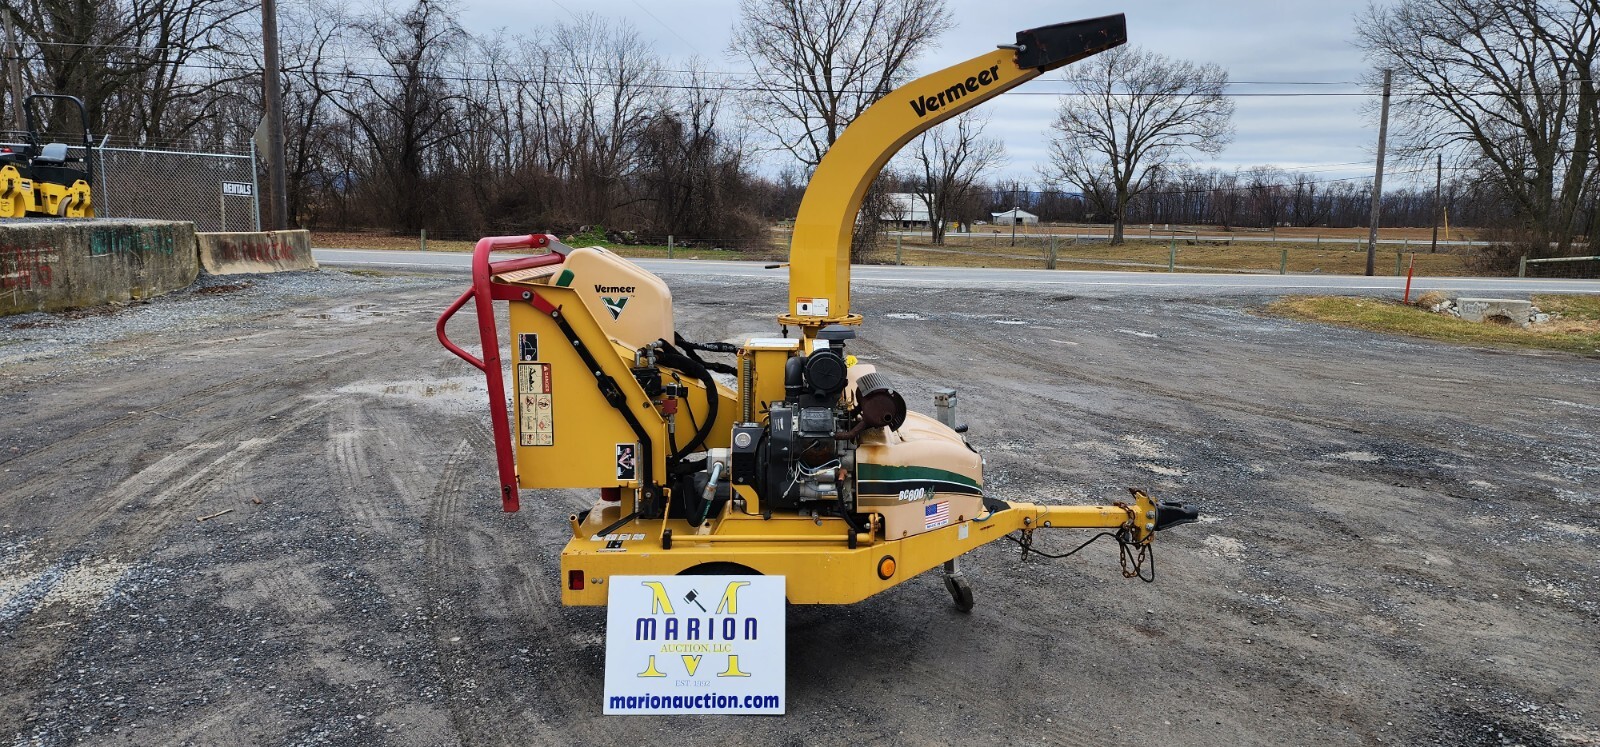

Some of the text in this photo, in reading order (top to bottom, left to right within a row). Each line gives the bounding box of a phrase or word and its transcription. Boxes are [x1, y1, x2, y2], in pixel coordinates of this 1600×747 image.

[909, 65, 999, 118] Vermeer
[223, 183, 252, 195] RENTALS
[594, 284, 636, 293] Vermeer
[635, 617, 758, 641] MARION
[660, 643, 732, 653] AUCTION, LLC
[609, 693, 779, 710] marionauction.com
